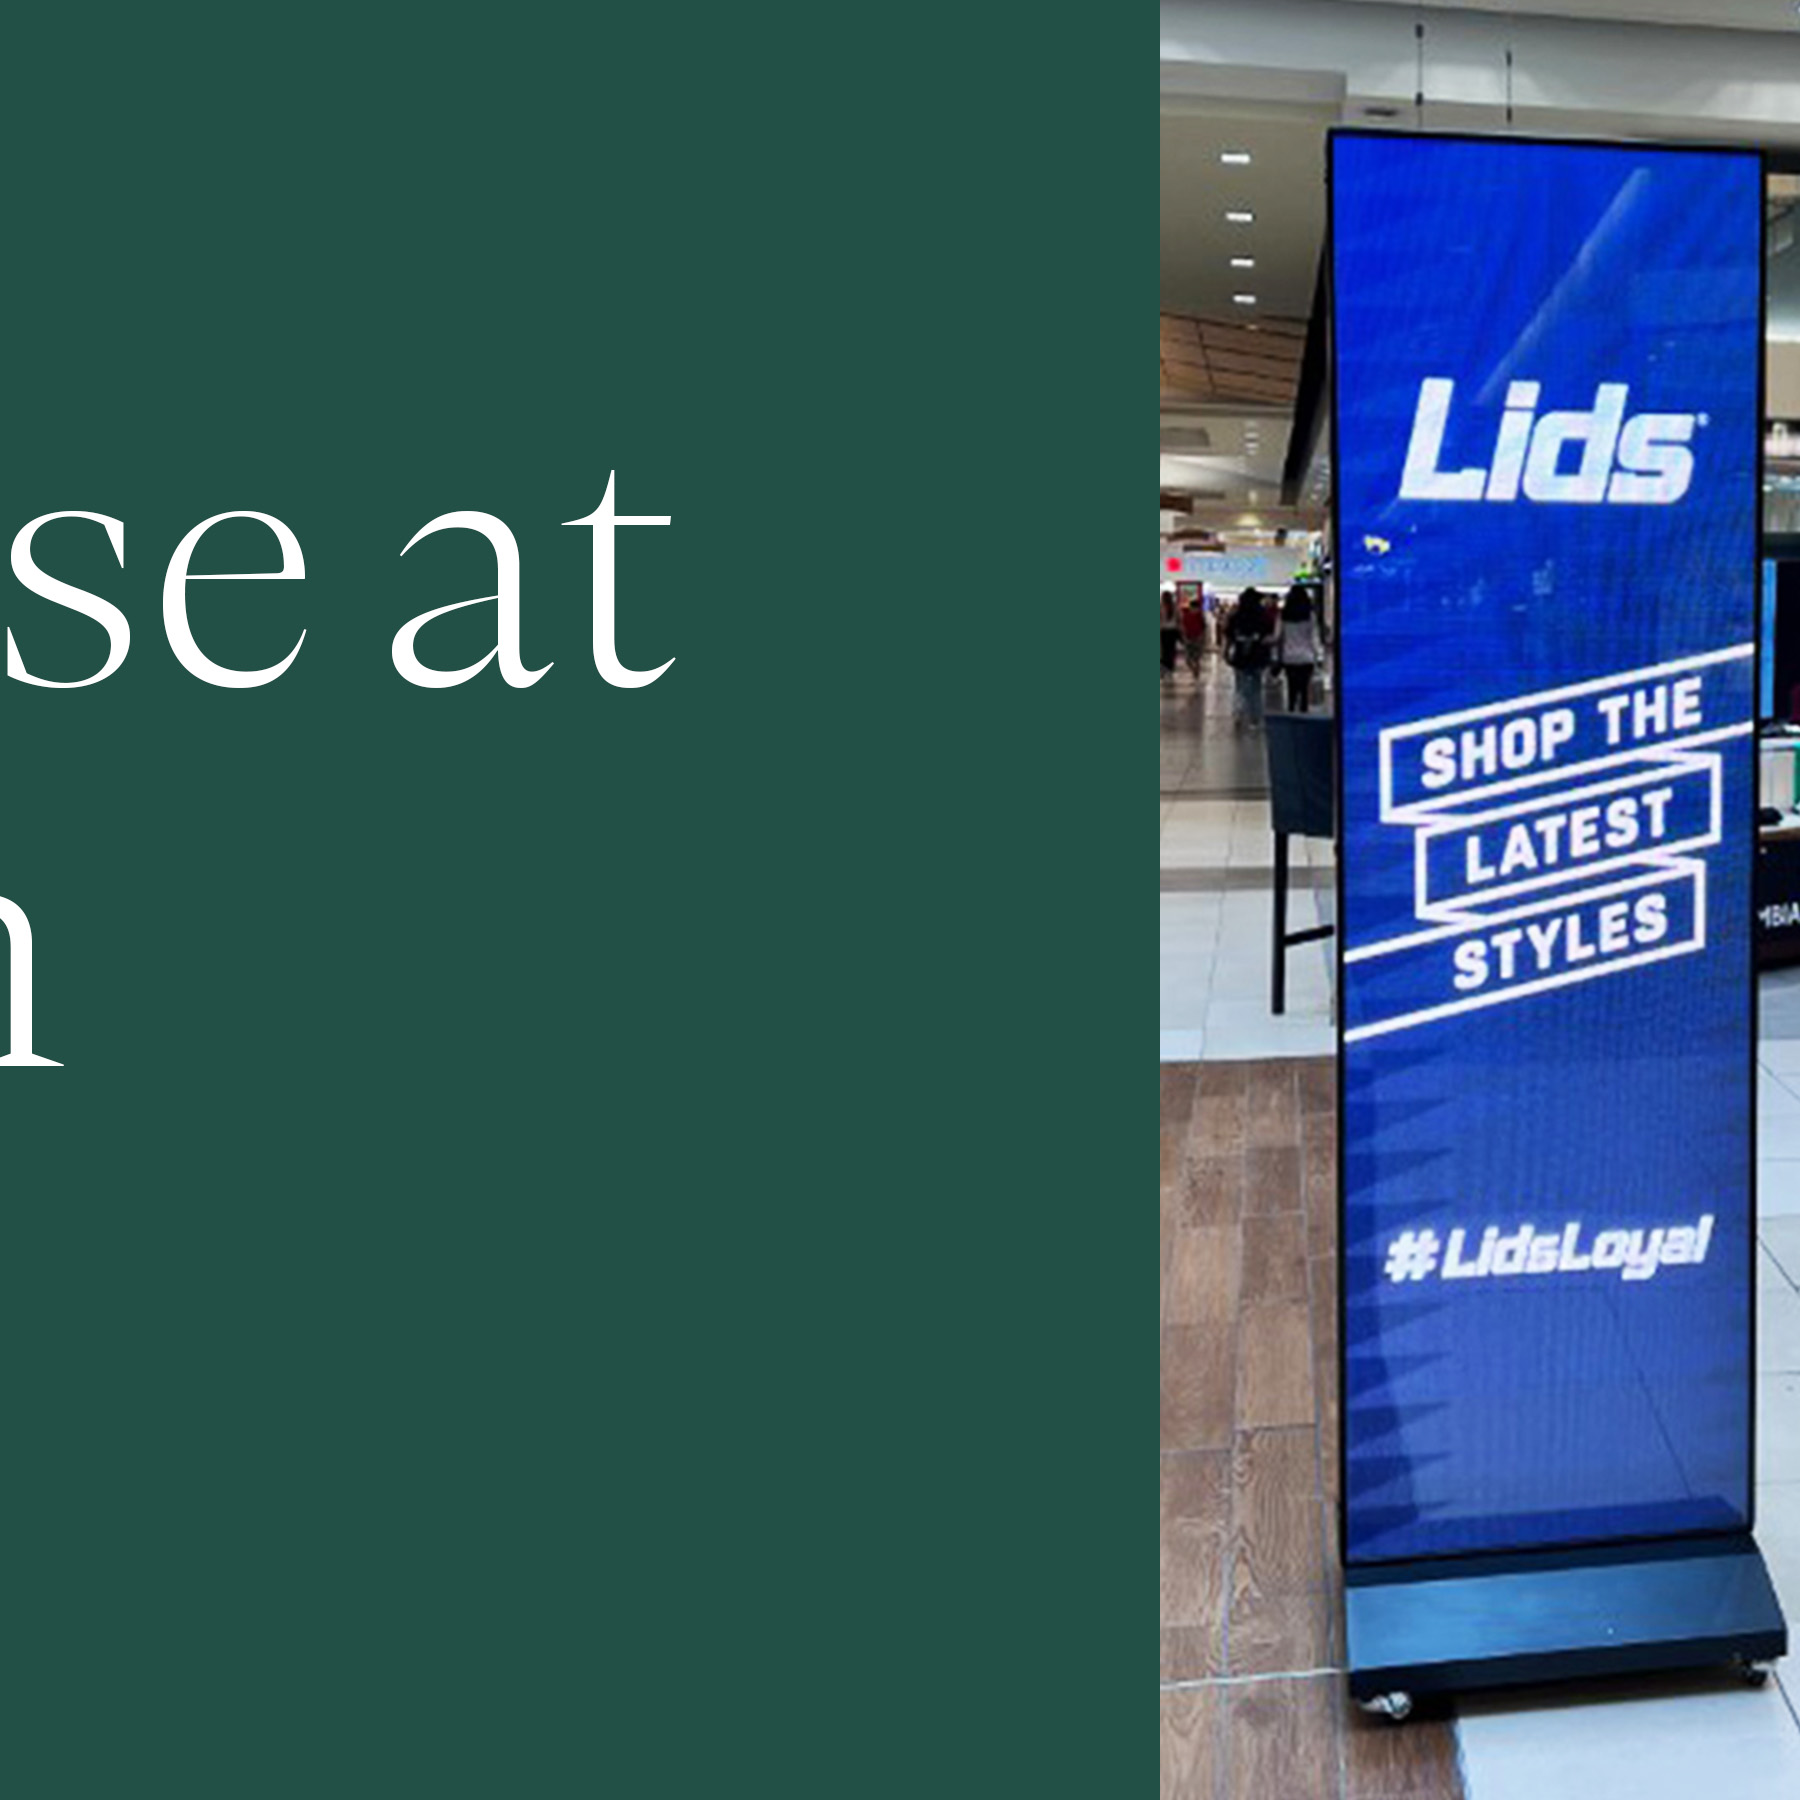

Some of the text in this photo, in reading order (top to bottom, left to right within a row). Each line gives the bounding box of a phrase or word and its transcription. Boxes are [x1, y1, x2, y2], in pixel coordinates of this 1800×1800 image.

[1399, 376, 1696, 504] Lids
[1421, 676, 1702, 789] SHOP THE
[1466, 787, 1673, 884] LATEST
[1453, 893, 1667, 990] STYLES
[1384, 1214, 1715, 1283] #LidsLoyal
